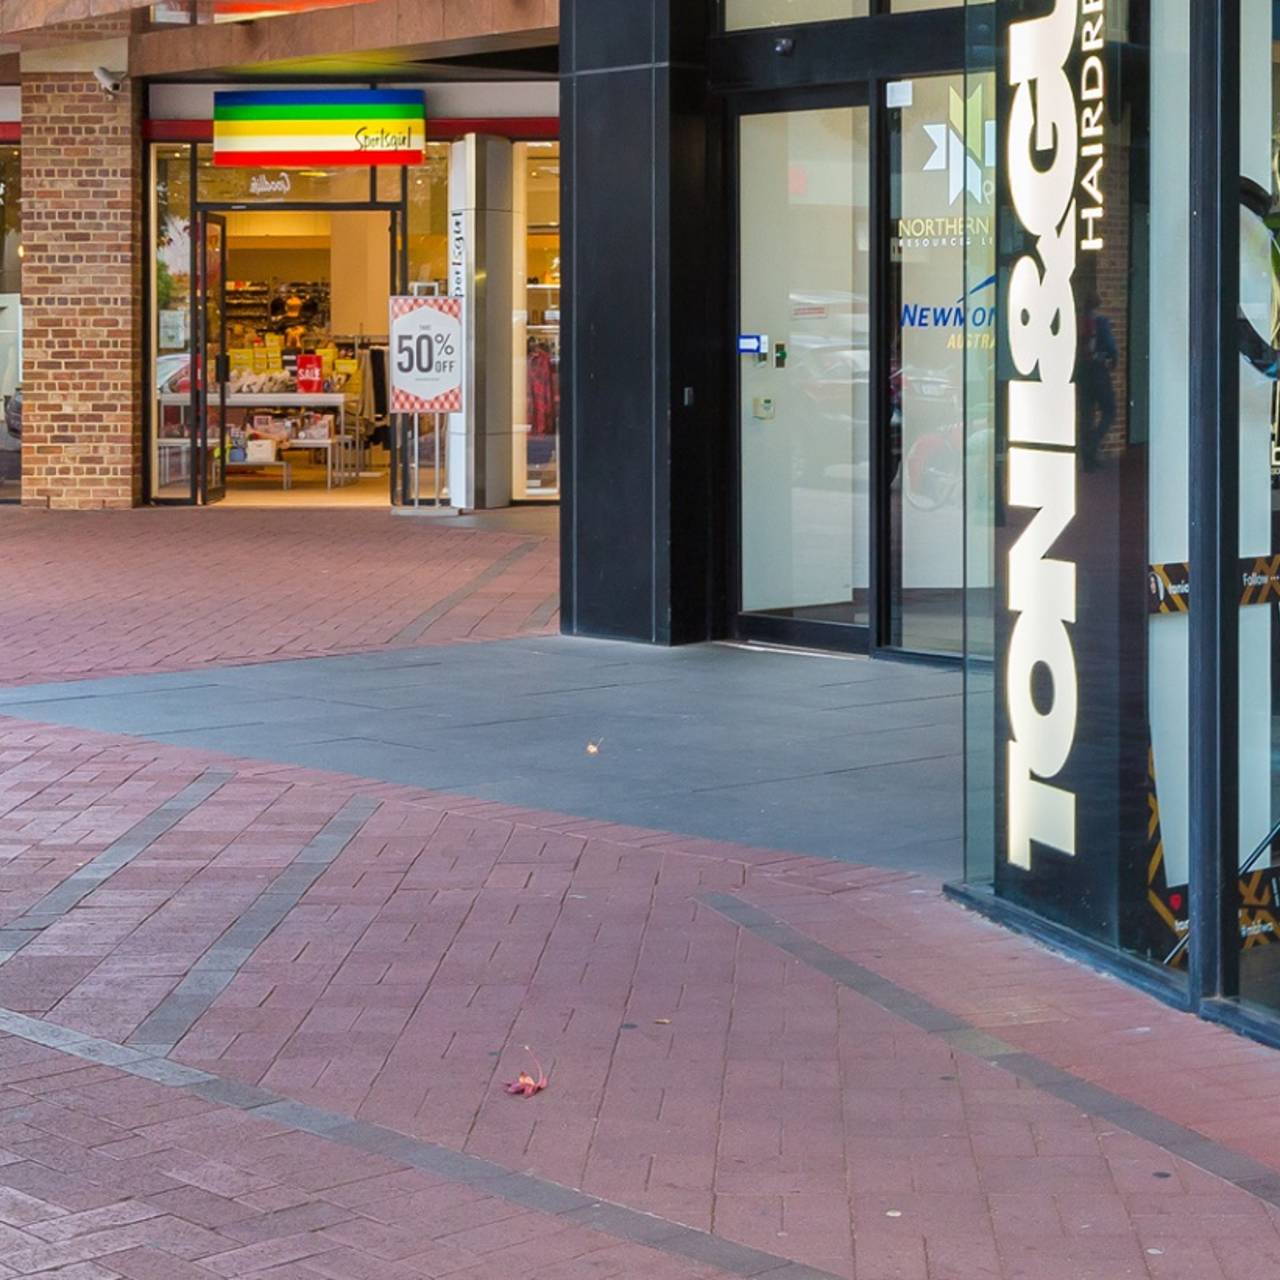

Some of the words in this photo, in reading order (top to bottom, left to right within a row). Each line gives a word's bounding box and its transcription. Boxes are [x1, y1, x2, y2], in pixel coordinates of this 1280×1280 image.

[354, 126, 412, 151] Sportsgirl
[899, 218, 988, 237] NORTHERN
[397, 333, 455, 373] 50%
[435, 360, 456, 373] OFF
